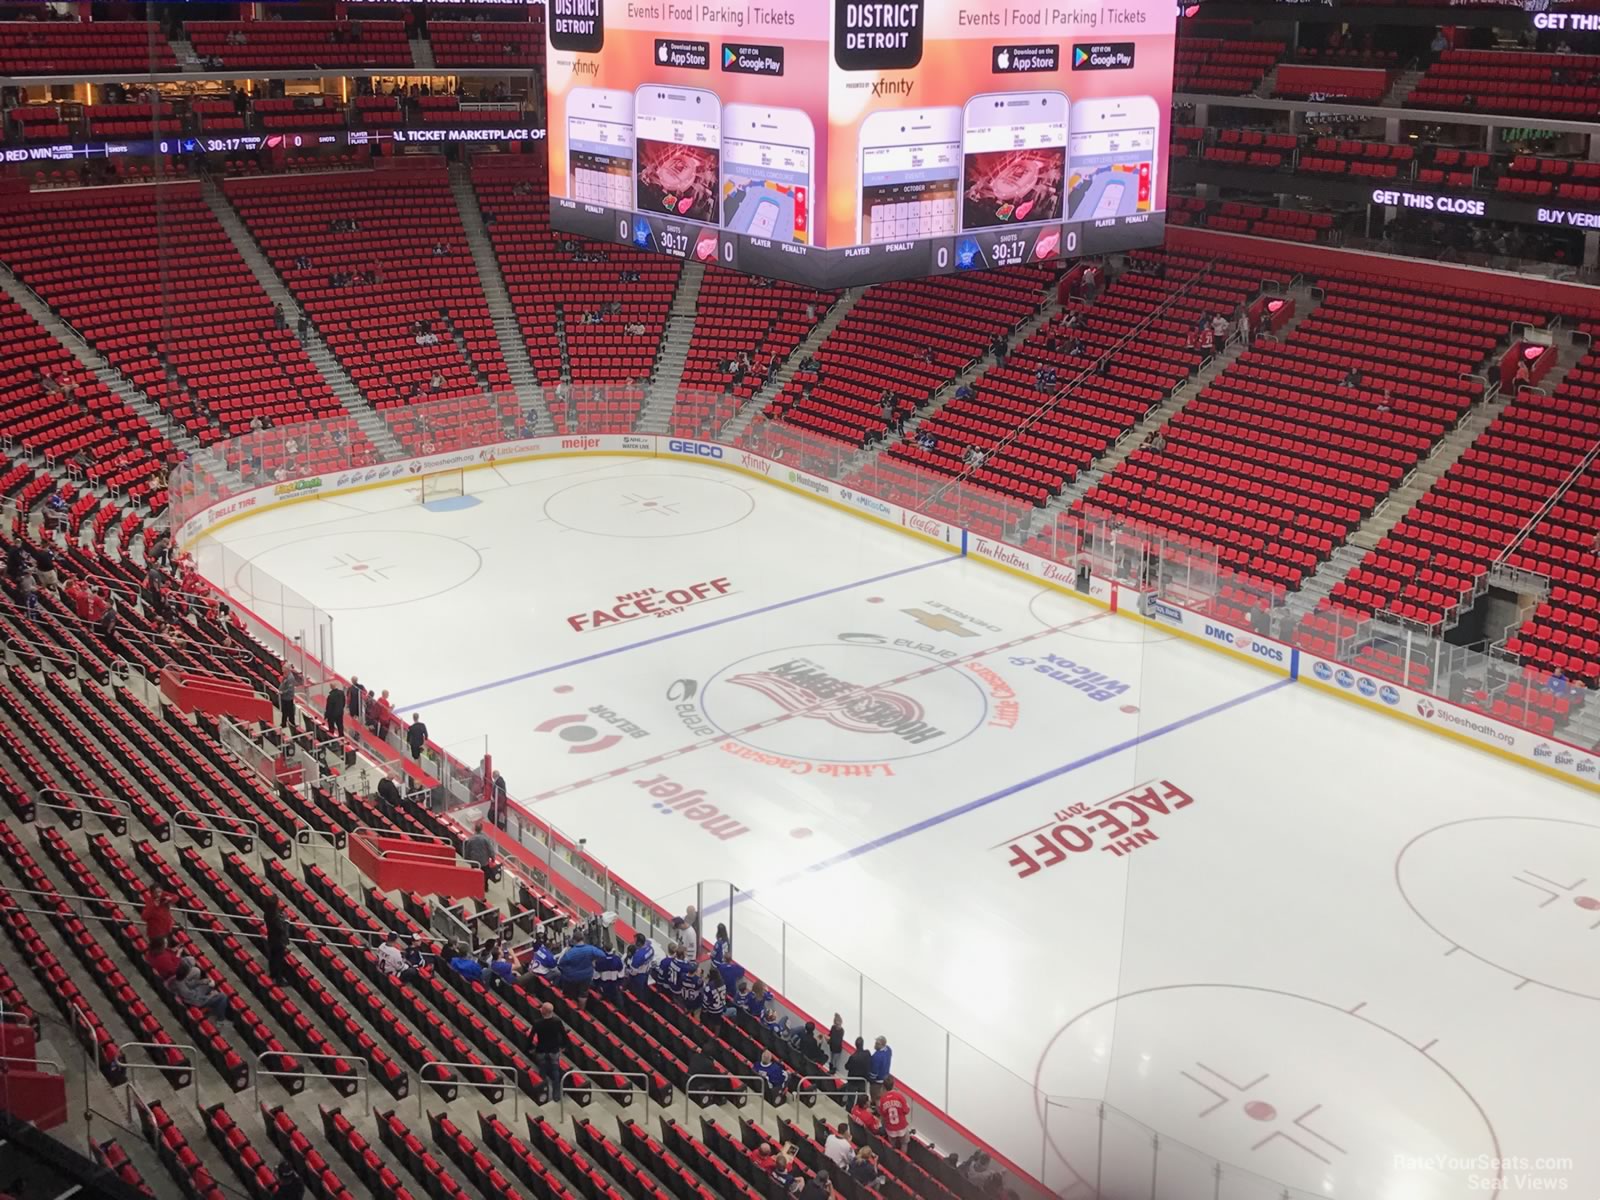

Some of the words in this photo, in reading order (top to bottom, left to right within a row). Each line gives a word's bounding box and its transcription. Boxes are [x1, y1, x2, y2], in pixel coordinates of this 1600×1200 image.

[555, 0, 599, 16] DISTRICT
[628, 3, 659, 19] Events
[668, 5, 693, 21] Food
[702, 6, 744, 26] Parking
[754, 8, 795, 25] Tickets
[846, 3, 919, 28] DISTRICT
[959, 9, 1000, 25] Events
[1012, 9, 1040, 24] Food
[1052, 8, 1097, 27] Parking
[1108, 7, 1146, 23] Tickets
[556, 19, 595, 34] DETROIT
[1534, 13, 1568, 29] GET
[1570, 14, 1600, 30] THI
[846, 32, 909, 49] DETROIT
[572, 59, 599, 77] xfinity
[671, 52, 686, 66] App
[686, 53, 706, 65] Store
[739, 55, 764, 71] Google
[765, 58, 780, 72] Play
[1013, 57, 1031, 71] App
[1032, 56, 1054, 68] Store
[1090, 53, 1116, 66] Google
[1117, 53, 1131, 65] Play
[872, 78, 914, 97] xfinity
[294, 136, 302, 147] 0
[408, 130, 447, 141] TICKET
[449, 129, 528, 141] MARKETPLACE
[530, 129, 546, 139] OF
[6, 149, 28, 162] RED
[30, 147, 52, 160] WIN
[160, 142, 168, 153] 0
[207, 139, 239, 151] 30:17
[903, 184, 926, 193] OCTOBER
[560, 200, 576, 209] PLAYER
[585, 204, 604, 215] PENALTY
[1372, 189, 1400, 205] GET
[1402, 193, 1433, 209] THIS
[1437, 197, 1485, 216] CLOSE
[1095, 218, 1116, 228] PLAYER
[1125, 215, 1149, 224] PENALTY
[1537, 208, 1564, 224] BUY
[620, 220, 628, 239] 0
[667, 225, 681, 234] SHOTS
[1000, 234, 1018, 242] SHOTS
[661, 232, 688, 251] 30:17
[750, 237, 772, 249] PLAYER
[782, 244, 807, 255] PENALTY
[886, 242, 915, 252] PENALTY
[992, 241, 1026, 260] 30:17
[1067, 231, 1077, 251] 0
[724, 242, 733, 262] 0
[845, 247, 870, 257] PLAYER
[937, 247, 948, 268] 0
[561, 436, 600, 450] meijer
[668, 440, 723, 459] GEICO
[741, 454, 771, 475] xfinity
[796, 472, 829, 494] Huntington
[215, 503, 236, 519] BELLE
[239, 497, 256, 509] TIRE
[975, 538, 992, 556] Tim
[993, 545, 1030, 572] Hortons
[616, 587, 662, 602] NHL
[567, 577, 731, 632] FACE-OFF
[654, 606, 686, 618] 2017
[923, 600, 1003, 633] CHEVROLET
[1204, 624, 1234, 644] DMC
[894, 638, 957, 659] arena
[1251, 642, 1283, 662] DOCS
[1008, 655, 1036, 667] &
[965, 661, 1016, 699] Caesars
[1034, 664, 1116, 702] Burns
[1040, 653, 1131, 696] Wilcox
[588, 704, 651, 740] BELFOR
[675, 703, 715, 737] arena
[988, 699, 1020, 730] Little
[720, 741, 814, 776] Caesars
[817, 761, 896, 778] Little
[632, 774, 751, 841] meijer
[1054, 802, 1091, 822] 2017
[1008, 780, 1194, 879] FACE-OFF
[1101, 828, 1160, 857] NHL
